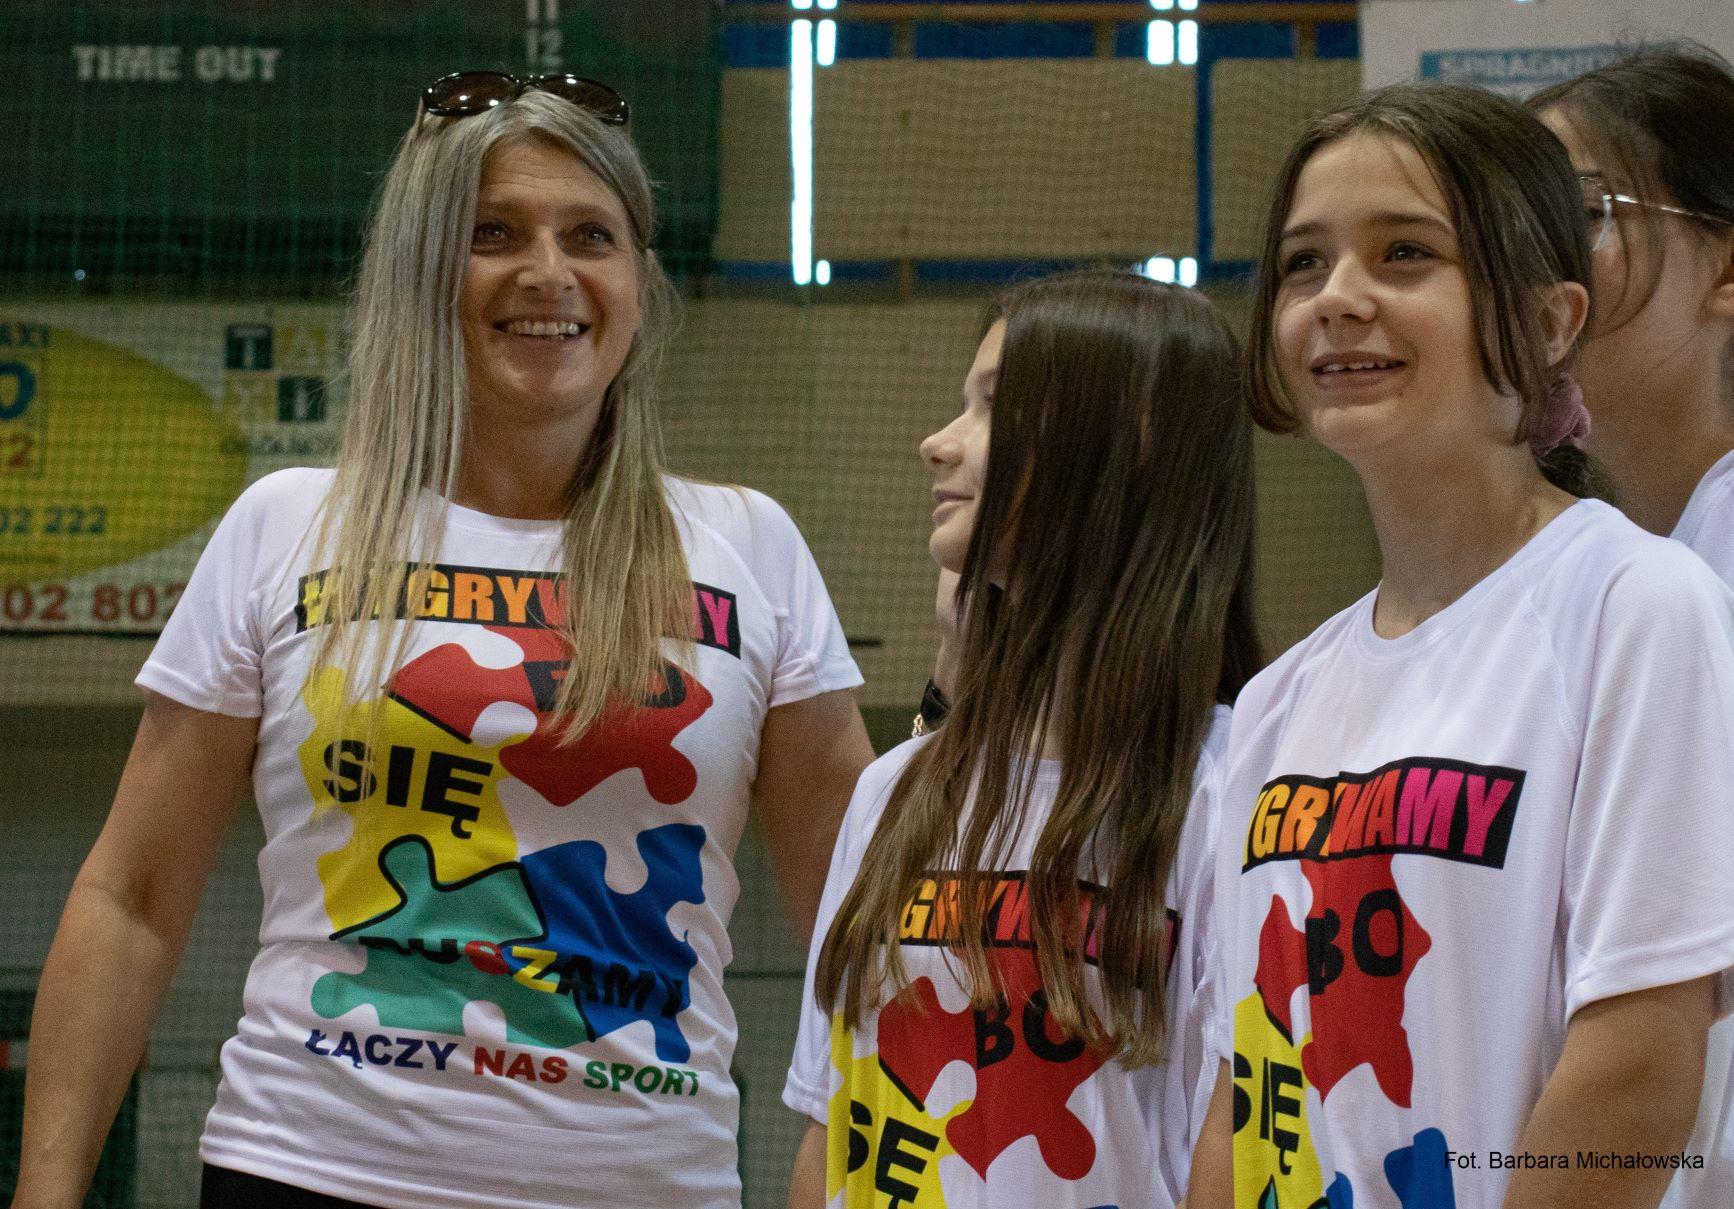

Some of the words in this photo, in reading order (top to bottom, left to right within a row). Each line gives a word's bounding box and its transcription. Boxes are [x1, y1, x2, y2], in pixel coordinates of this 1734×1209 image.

[73, 46, 182, 81] TIME
[195, 46, 282, 81] OUT
[323, 739, 493, 839] SIĘ
[1305, 888, 1404, 996] BO
[305, 1029, 458, 1070] ŁĄCZY
[474, 1046, 569, 1083] NAS
[583, 1060, 699, 1097] SPORT
